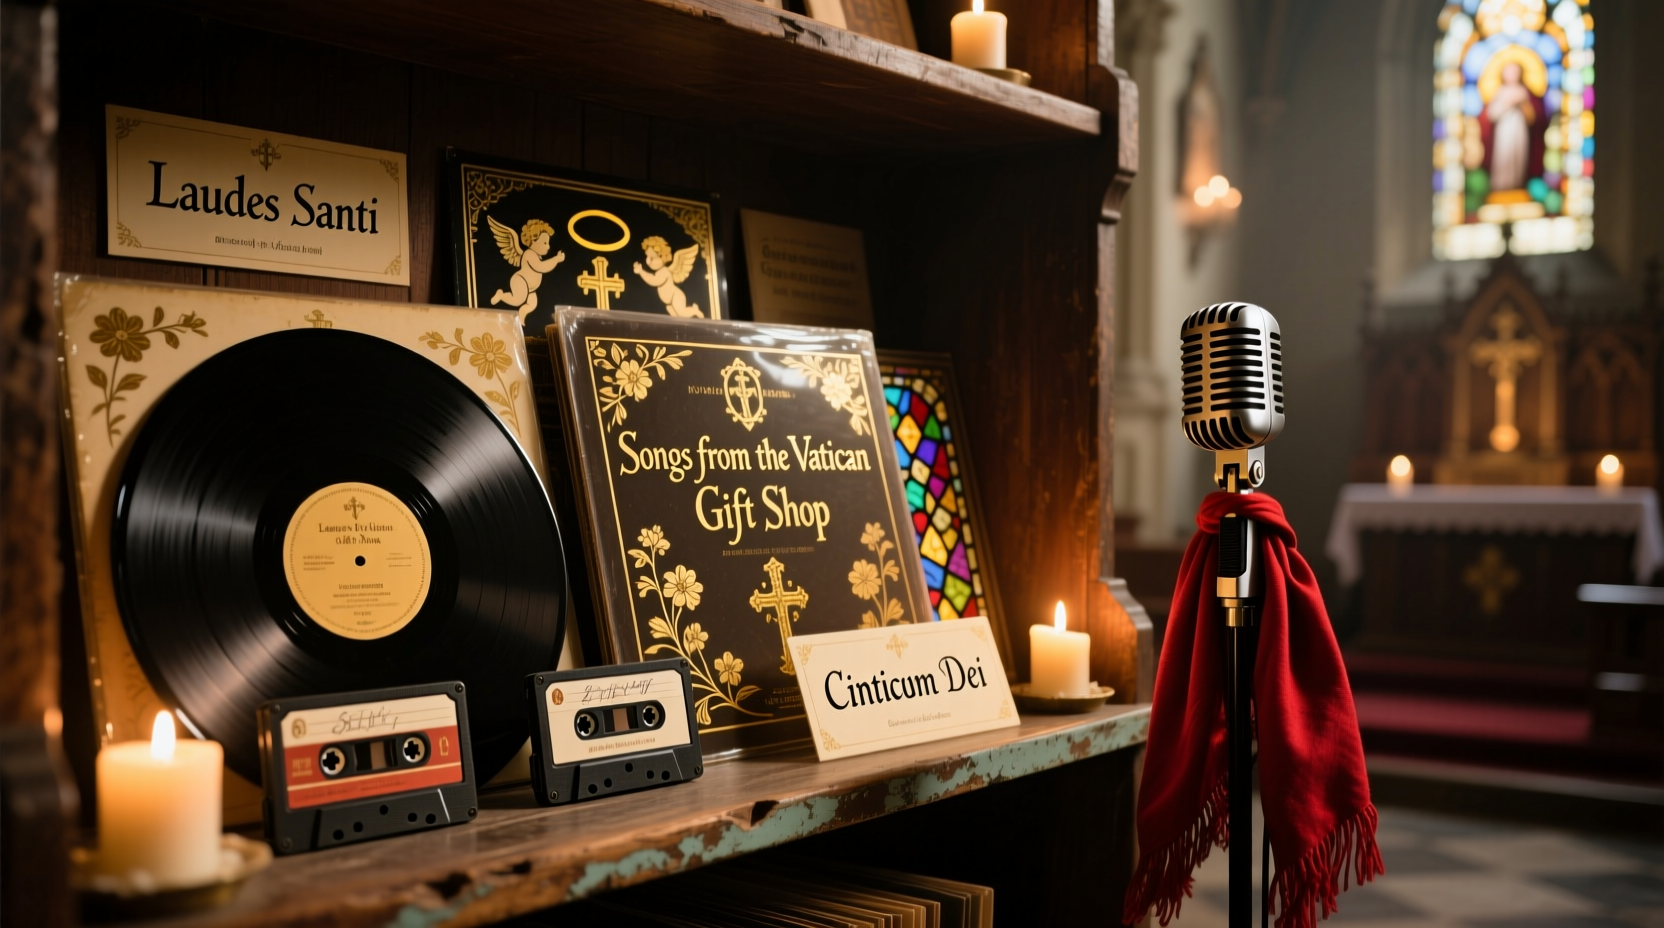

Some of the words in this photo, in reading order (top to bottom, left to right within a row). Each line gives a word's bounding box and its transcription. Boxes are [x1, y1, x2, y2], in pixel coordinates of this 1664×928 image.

[146, 160, 280, 222] Laudes
[291, 183, 379, 234] Santi
[618, 431, 694, 483] Songs
[694, 435, 752, 484] from
[755, 437, 790, 471] the
[787, 435, 871, 472] Vatican
[695, 485, 757, 546] Gift
[761, 485, 831, 542] Shop
[824, 669, 939, 711] Cinticum
[938, 655, 987, 693] Dei
